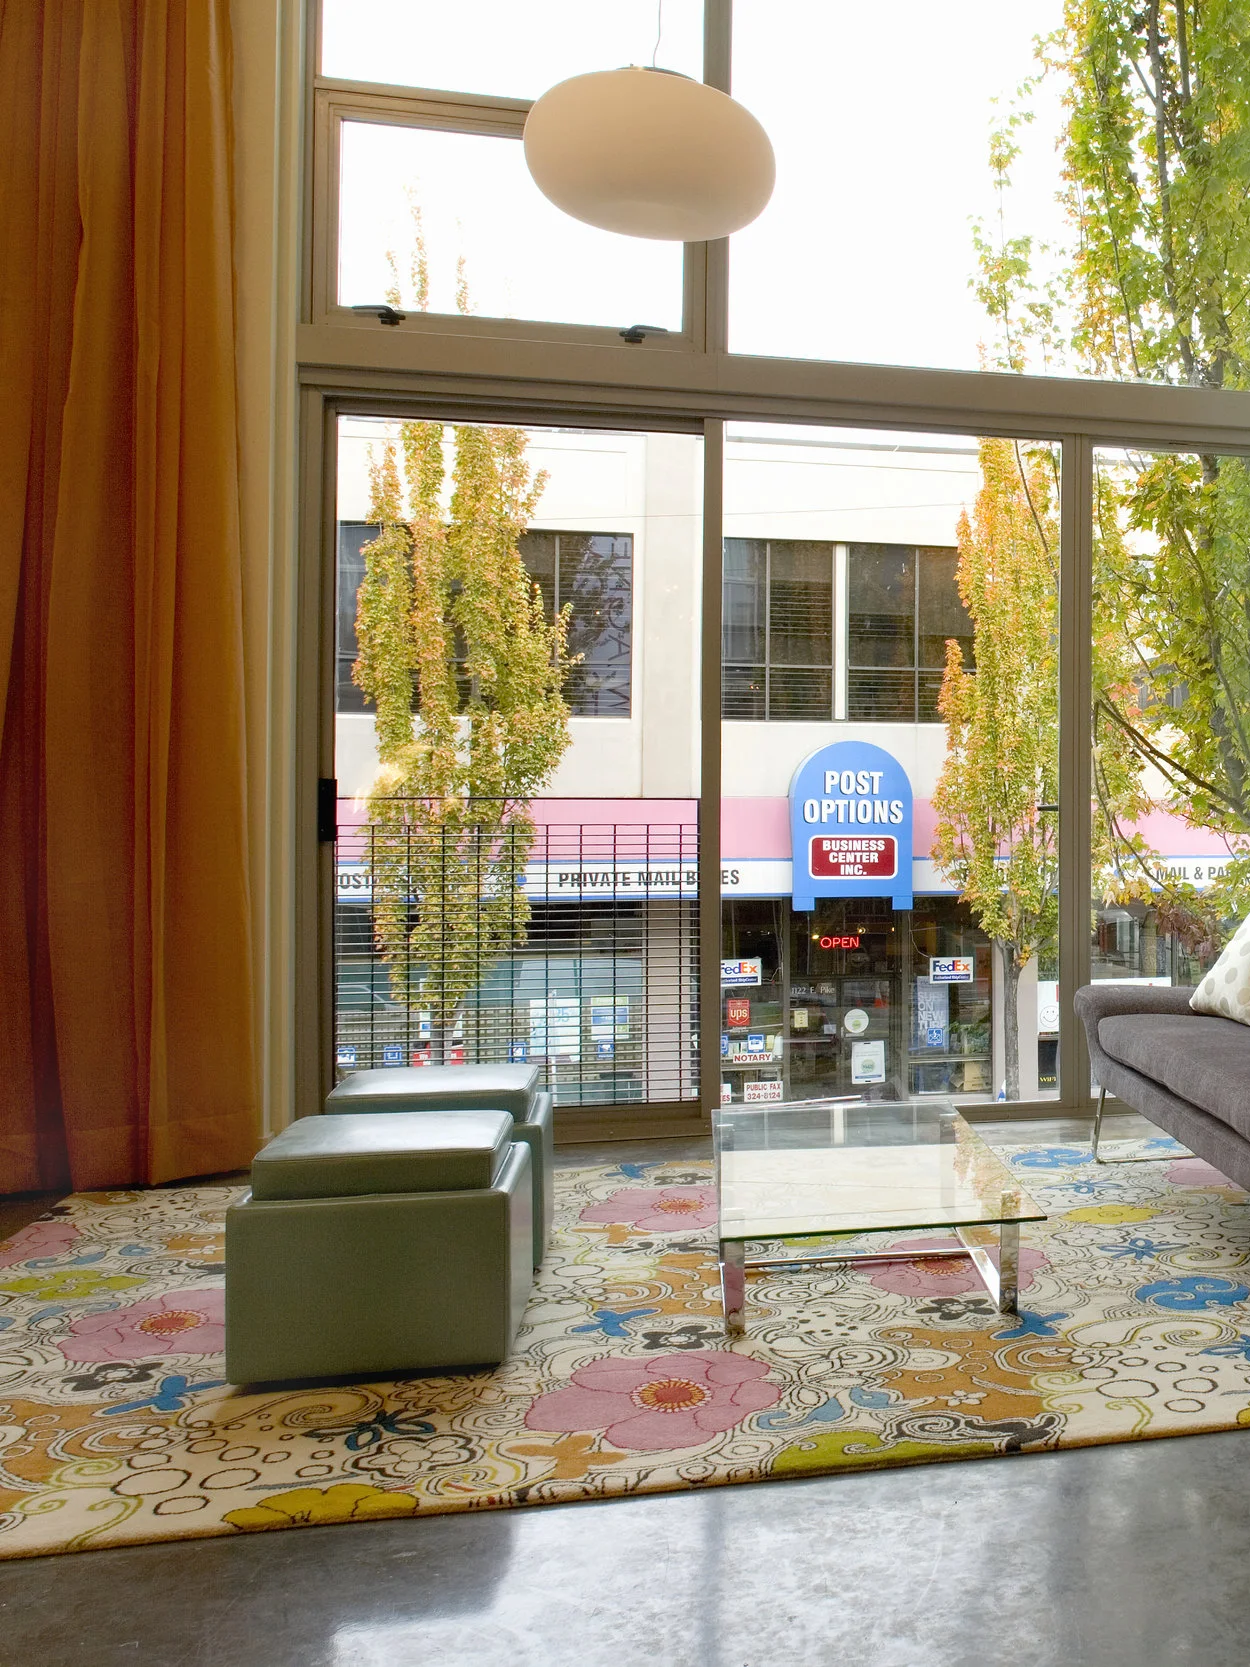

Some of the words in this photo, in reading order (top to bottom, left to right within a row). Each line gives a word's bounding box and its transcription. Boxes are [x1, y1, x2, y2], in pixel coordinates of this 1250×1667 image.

[824, 770, 883, 795] POST
[803, 799, 904, 824] OPTIONS
[822, 840, 885, 851] BUSINESS
[829, 852, 879, 863] CENTER
[840, 864, 867, 875] INC.
[1156, 866, 1189, 880] MAIL
[1193, 866, 1203, 880] &
[559, 871, 631, 888] PRIVATE
[638, 870, 682, 887] MAIL
[820, 937, 859, 948] OPEN
[933, 960, 970, 972] FedEx
[820, 986, 835, 994] Pike
[918, 1001, 934, 1011] ON
[730, 1009, 748, 1020] ups
[918, 1010, 943, 1021] NEW
[734, 1053, 771, 1062] NOTARY
